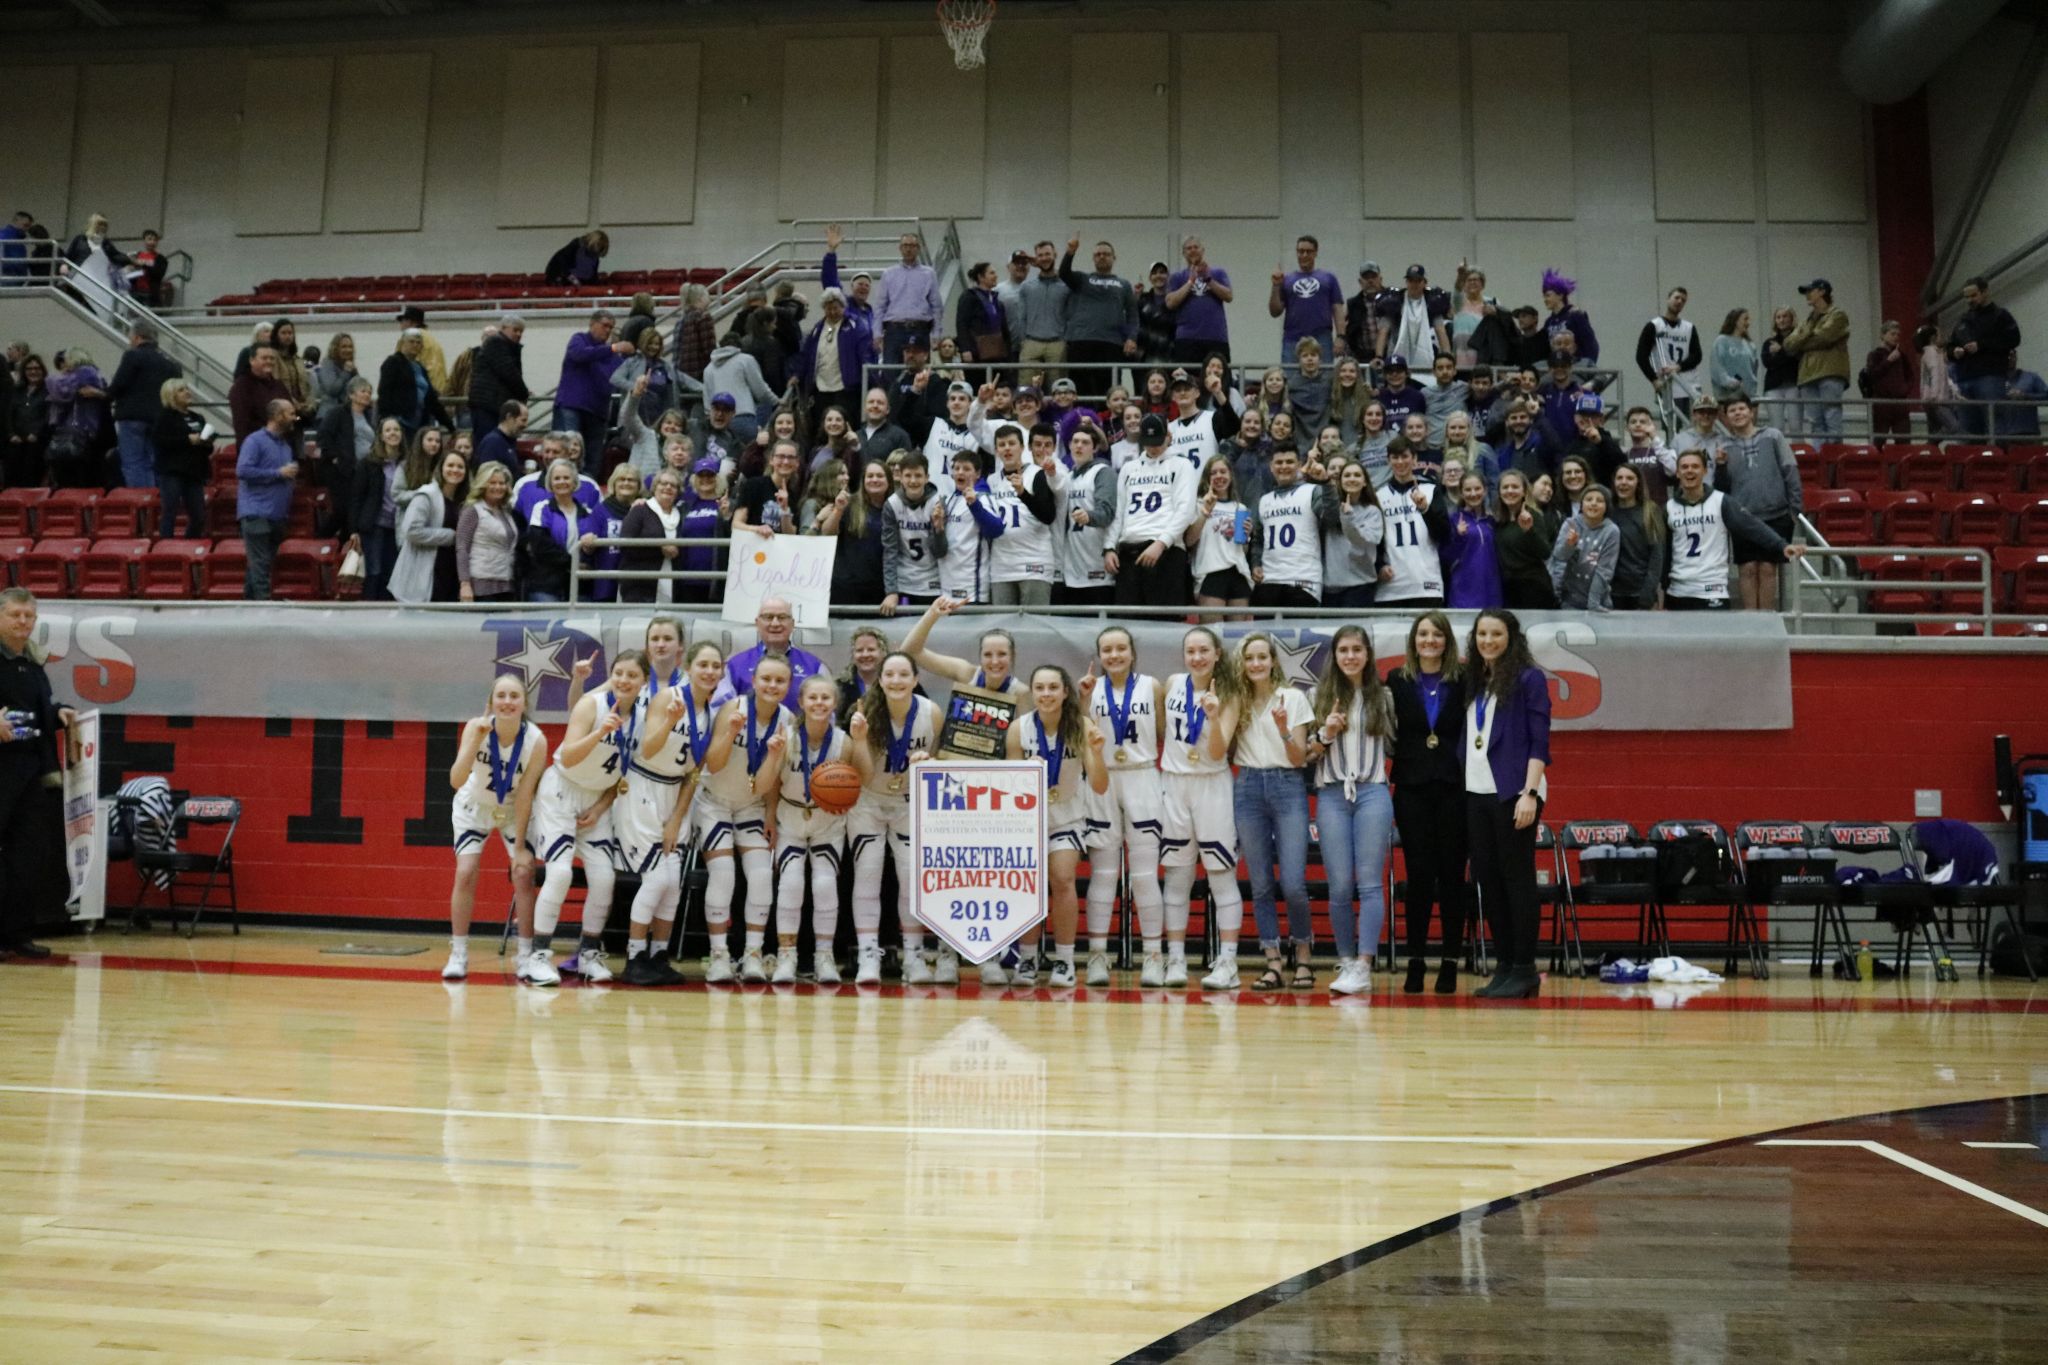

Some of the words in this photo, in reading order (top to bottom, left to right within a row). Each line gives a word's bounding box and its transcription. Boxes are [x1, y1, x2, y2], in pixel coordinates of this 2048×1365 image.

[1129, 475, 1169, 486] CLASSICAL
[1128, 491, 1162, 515] 50
[1264, 506, 1302, 520] CLASSICAL
[1673, 514, 1716, 527] CLASSICAL
[1268, 523, 1296, 550] 10
[1394, 521, 1420, 547] 11
[909, 538, 924, 561] 5
[1686, 533, 1701, 557] 2
[952, 697, 1011, 731] TAPPS
[602, 753, 620, 775] 4
[675, 743, 691, 766] 5
[185, 801, 232, 817] WEST
[924, 826, 979, 834] COMPETITION
[1004, 826, 1035, 834] HONOR
[1571, 825, 1629, 844] WEST
[1745, 825, 1803, 844] WEST
[1831, 827, 1890, 844] WEST
[922, 846, 1037, 869] BASKETBALL
[922, 870, 1037, 895] CHAMPION
[950, 900, 1009, 921] 2019
[968, 927, 992, 942] 3A
